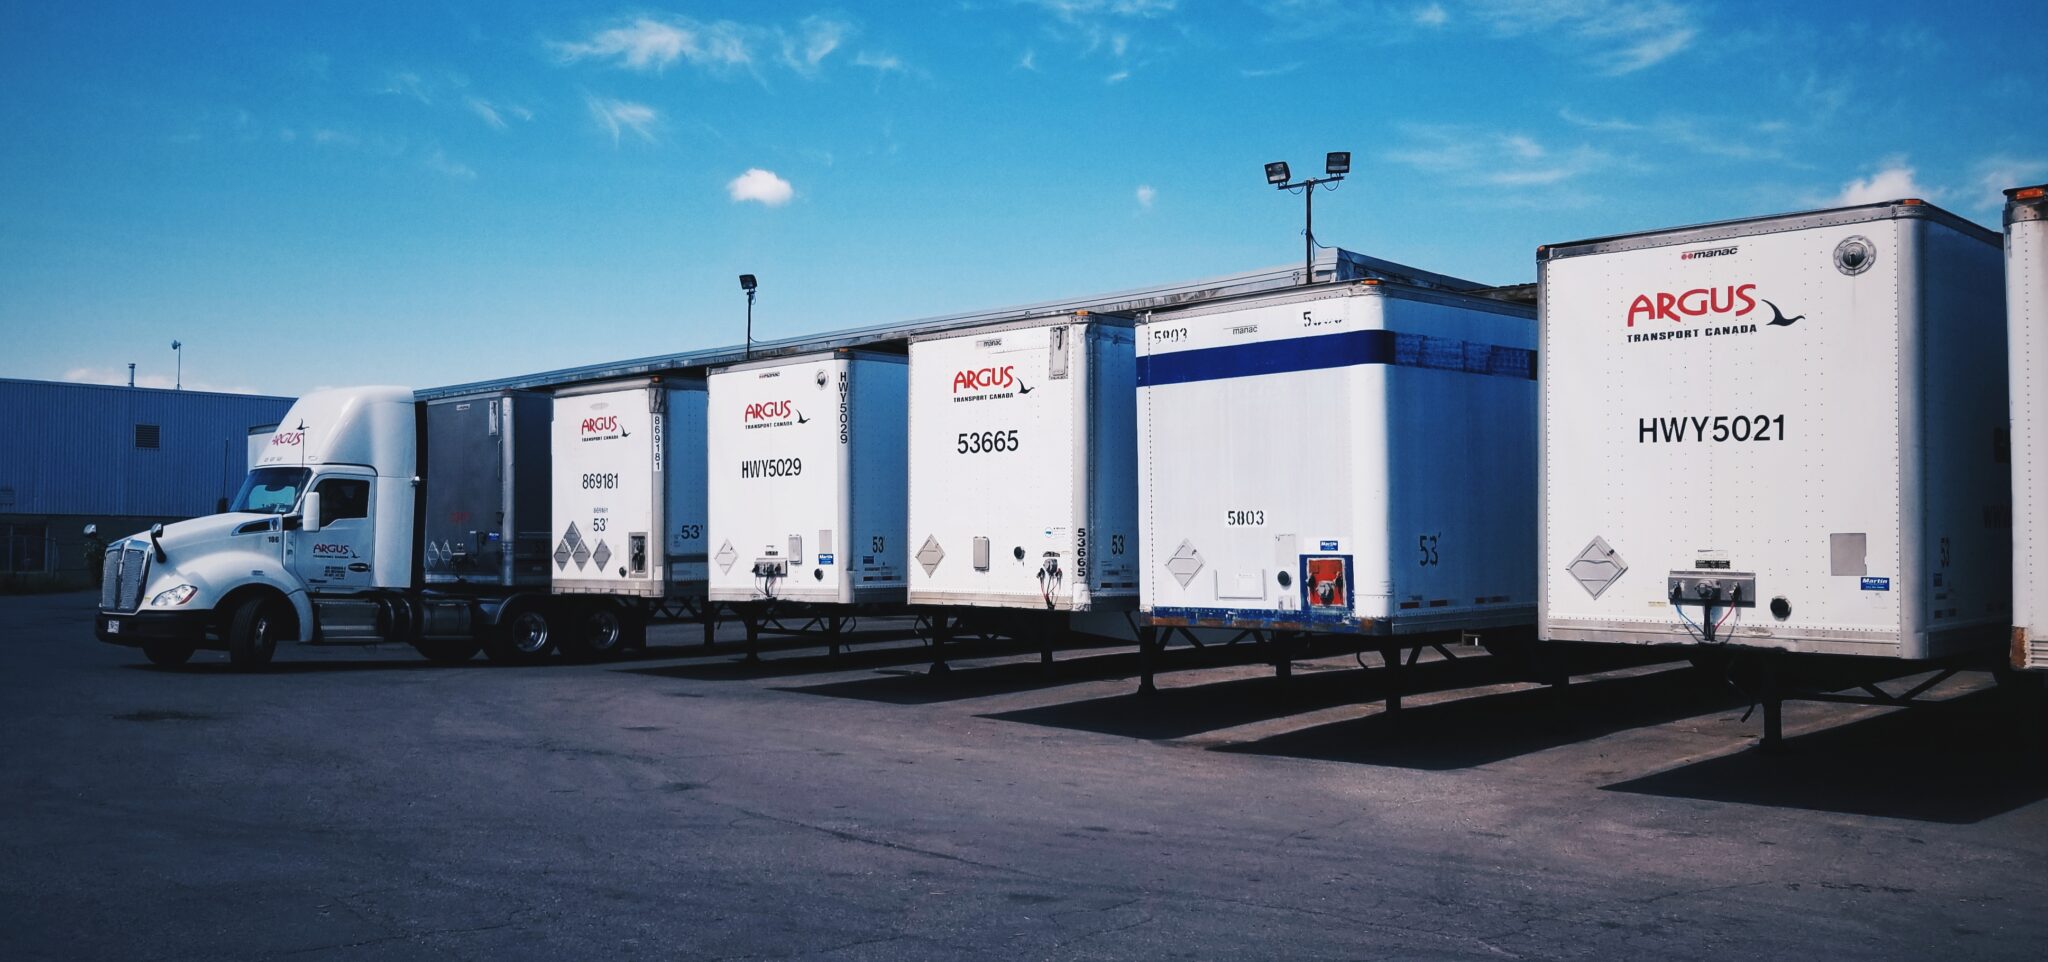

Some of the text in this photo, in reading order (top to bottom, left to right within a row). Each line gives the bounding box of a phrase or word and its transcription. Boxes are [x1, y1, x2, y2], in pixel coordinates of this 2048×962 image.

[1694, 247, 1738, 259] manac
[1627, 284, 1756, 327] ARGUS
[1232, 325, 1258, 335] manac
[1627, 324, 1757, 343] TRANSPORT CANADA
[953, 366, 1014, 393] ARGUS
[838, 371, 849, 444] HWY5029
[953, 392, 1014, 403] TRANSPORT CANADA
[745, 400, 792, 422] ARGUS
[582, 416, 617, 435] ARGUS
[1639, 414, 1785, 443] HWY5021
[957, 430, 1019, 454] 53665
[742, 457, 802, 479] HWY5029
[582, 473, 619, 490] 869181
[1228, 510, 1264, 525] 5803
[313, 544, 350, 555] ARGUS
[1077, 527, 1086, 577] 53665
